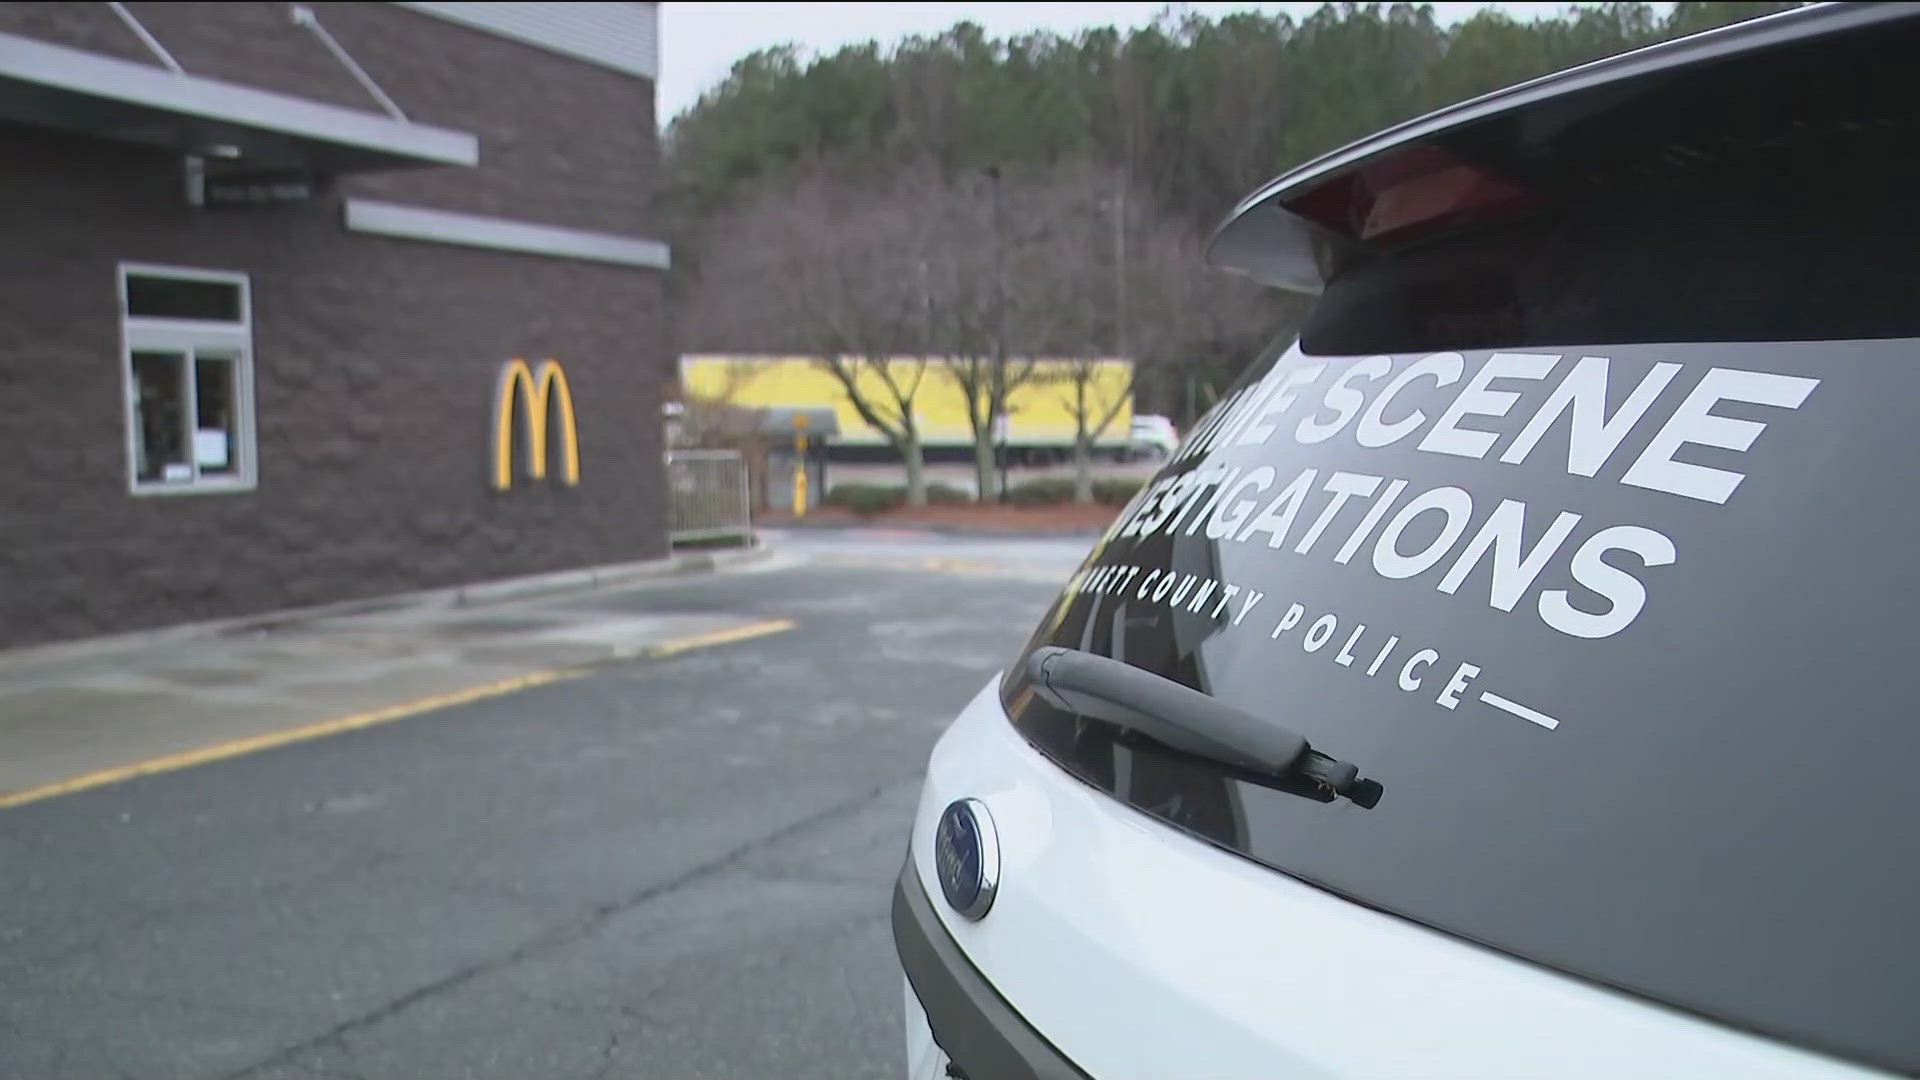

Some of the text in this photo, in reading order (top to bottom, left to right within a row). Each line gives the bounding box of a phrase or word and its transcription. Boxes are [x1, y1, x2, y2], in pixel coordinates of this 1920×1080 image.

[1294, 352, 1820, 505] SCENE
[1137, 568, 1264, 626] COUNTY
[1271, 603, 1482, 711] POLICE
